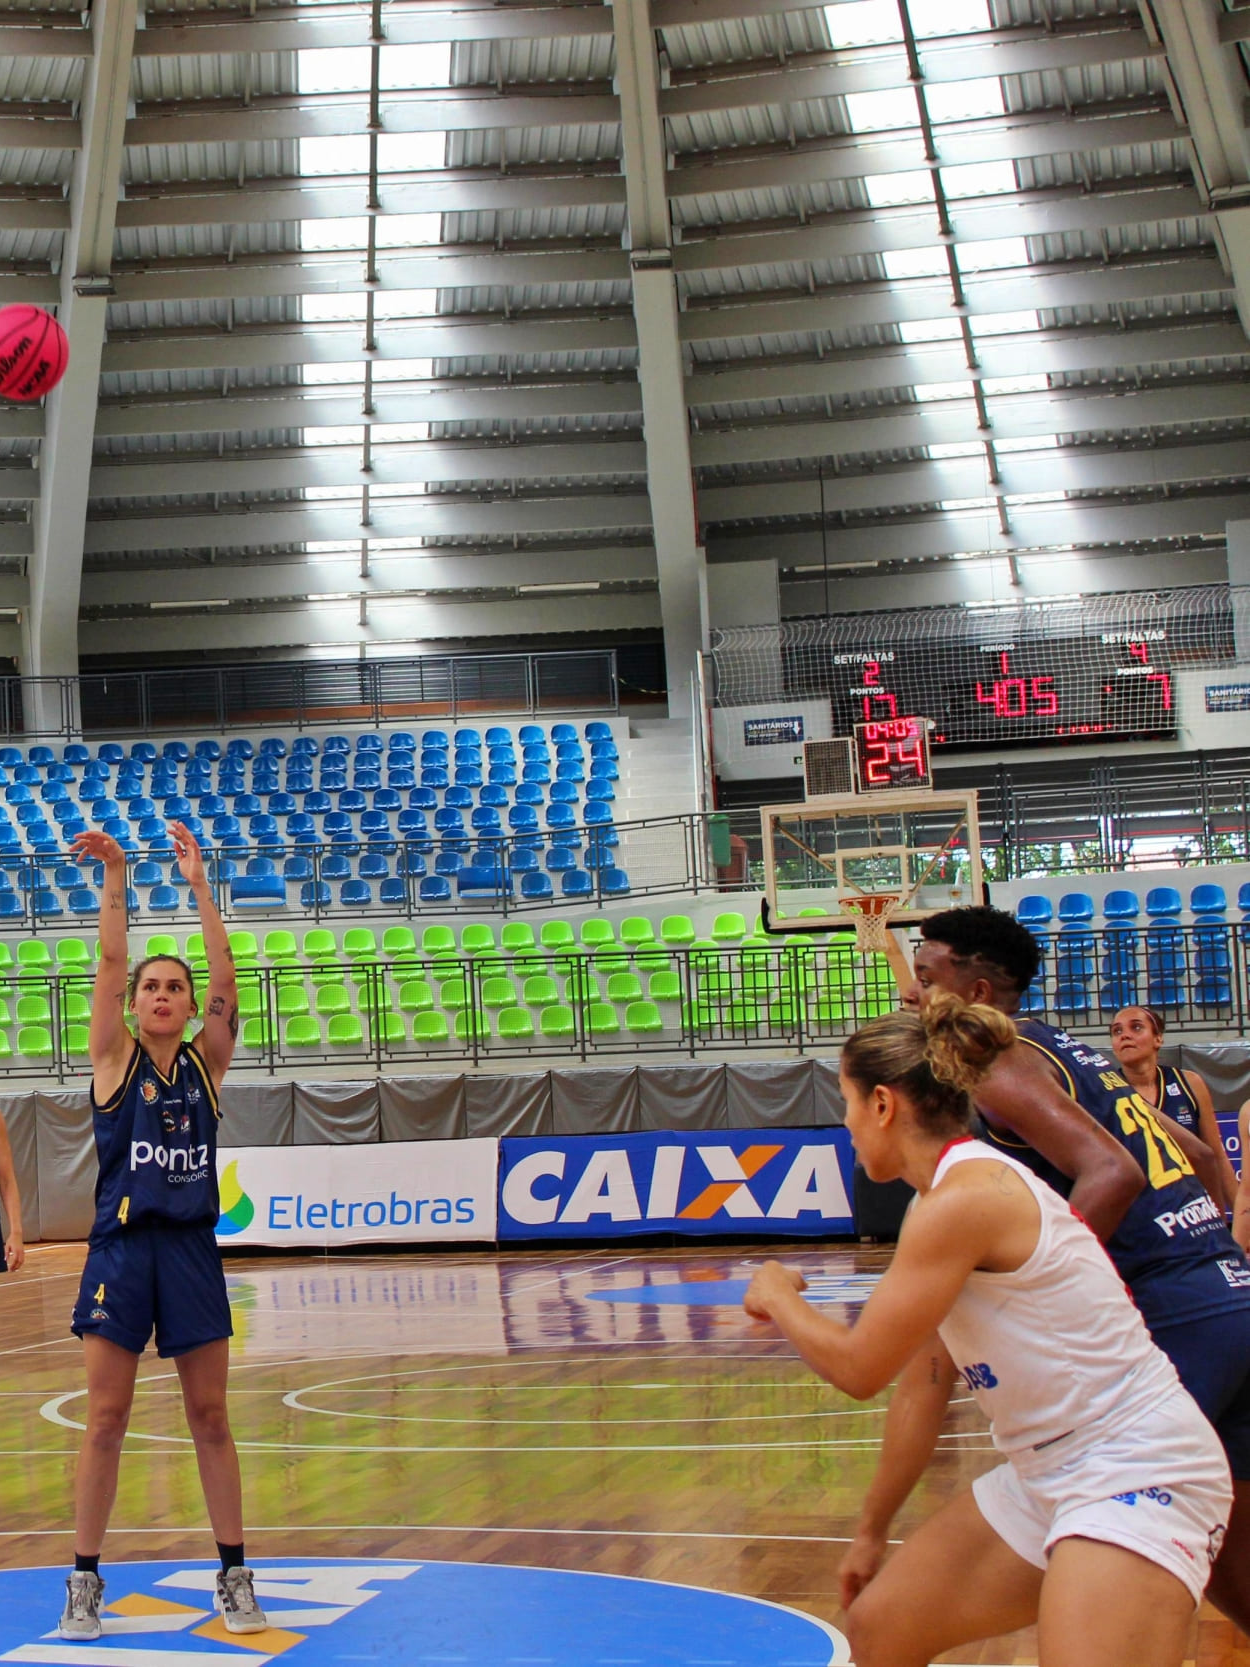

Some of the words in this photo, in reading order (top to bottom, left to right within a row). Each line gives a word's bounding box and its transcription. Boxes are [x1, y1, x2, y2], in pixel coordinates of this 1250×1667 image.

[1102, 630, 1165, 645] SET/FALTAS
[834, 652, 895, 665] SET/FALTAS
[1001, 652, 1009, 674] 1
[1130, 642, 1148, 664] 4
[863, 662, 880, 686] 2
[1117, 666, 1154, 676] PONTOS
[850, 687, 884, 696] PONTOS
[1146, 674, 1171, 710] 7
[863, 693, 897, 720] 17
[748, 721, 794, 731] SANITÁRIOS
[864, 717, 919, 740] 04:05
[866, 739, 925, 782] 24
[130, 1140, 208, 1171] pontz
[503, 1144, 853, 1225] CAIXA
[117, 1196, 130, 1225] 4
[268, 1191, 476, 1230] Eletrobras
[94, 1283, 105, 1305] 4
